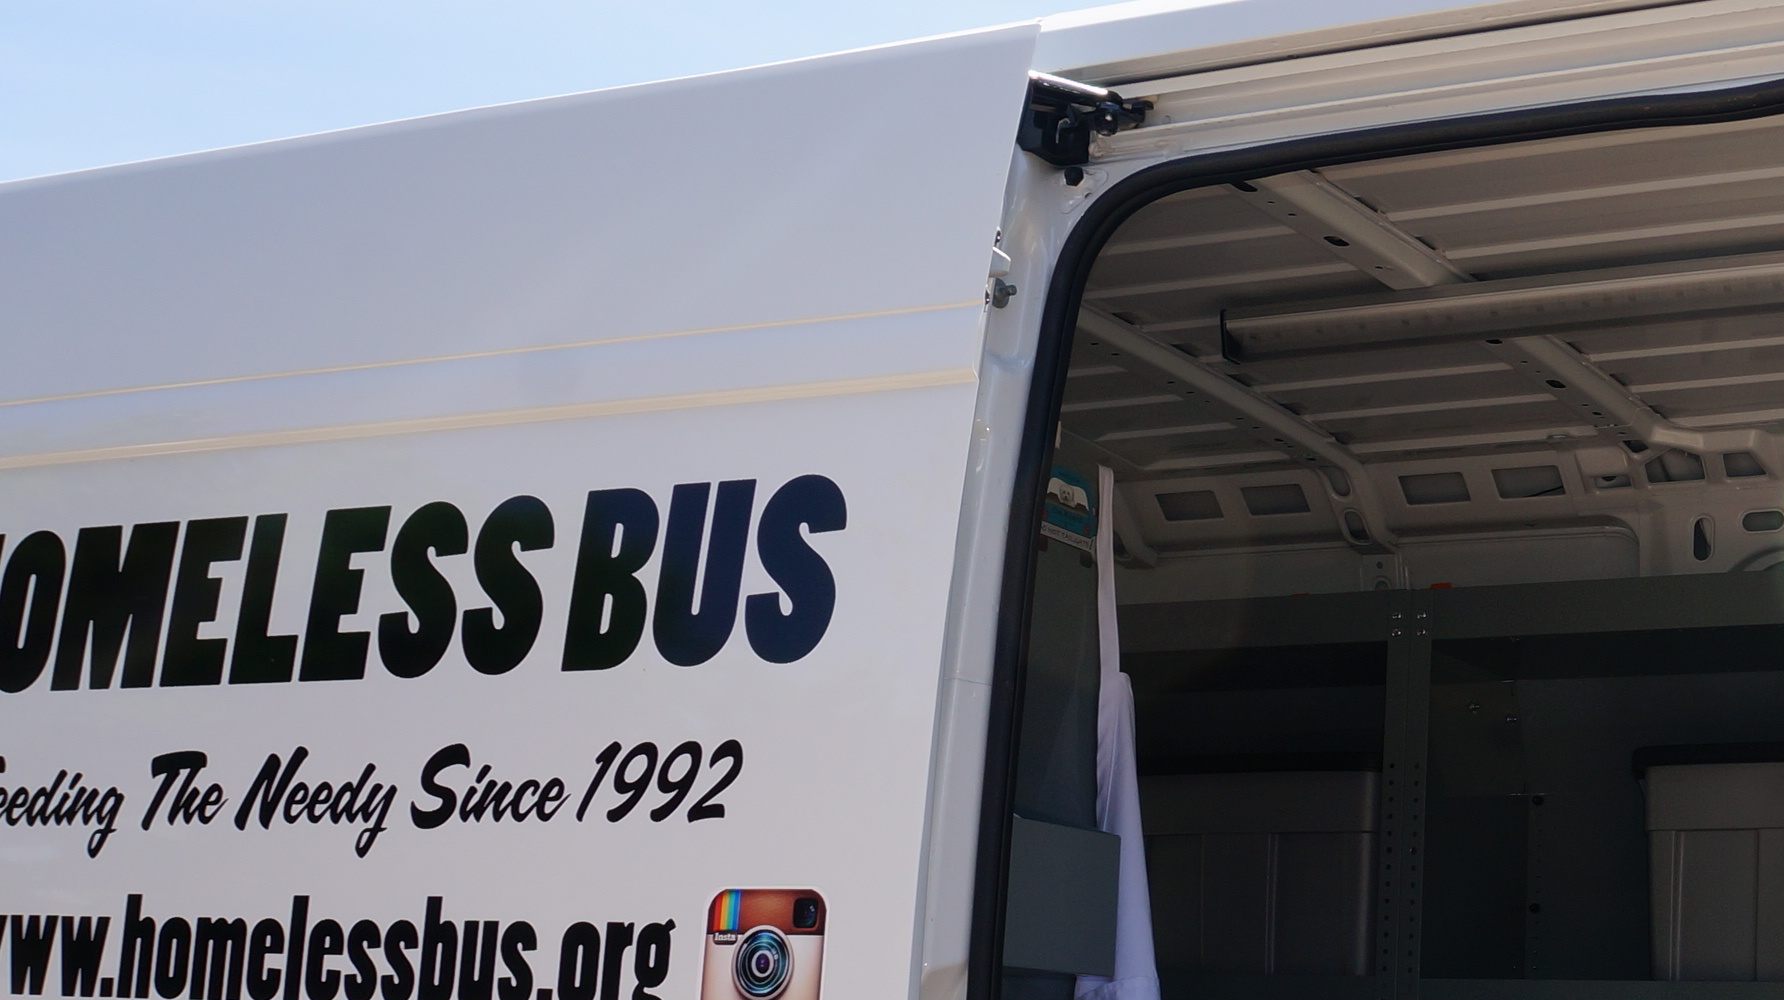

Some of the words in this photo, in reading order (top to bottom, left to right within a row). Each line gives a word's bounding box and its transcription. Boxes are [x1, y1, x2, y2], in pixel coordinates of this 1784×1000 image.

[0, 494, 555, 694] OMELESS
[560, 473, 848, 672] BUS
[0, 755, 125, 859] eding
[140, 750, 229, 832] The
[233, 745, 398, 859] Needy
[410, 742, 572, 830] Since
[575, 739, 744, 824] 1992
[714, 932, 736, 942] Insta
